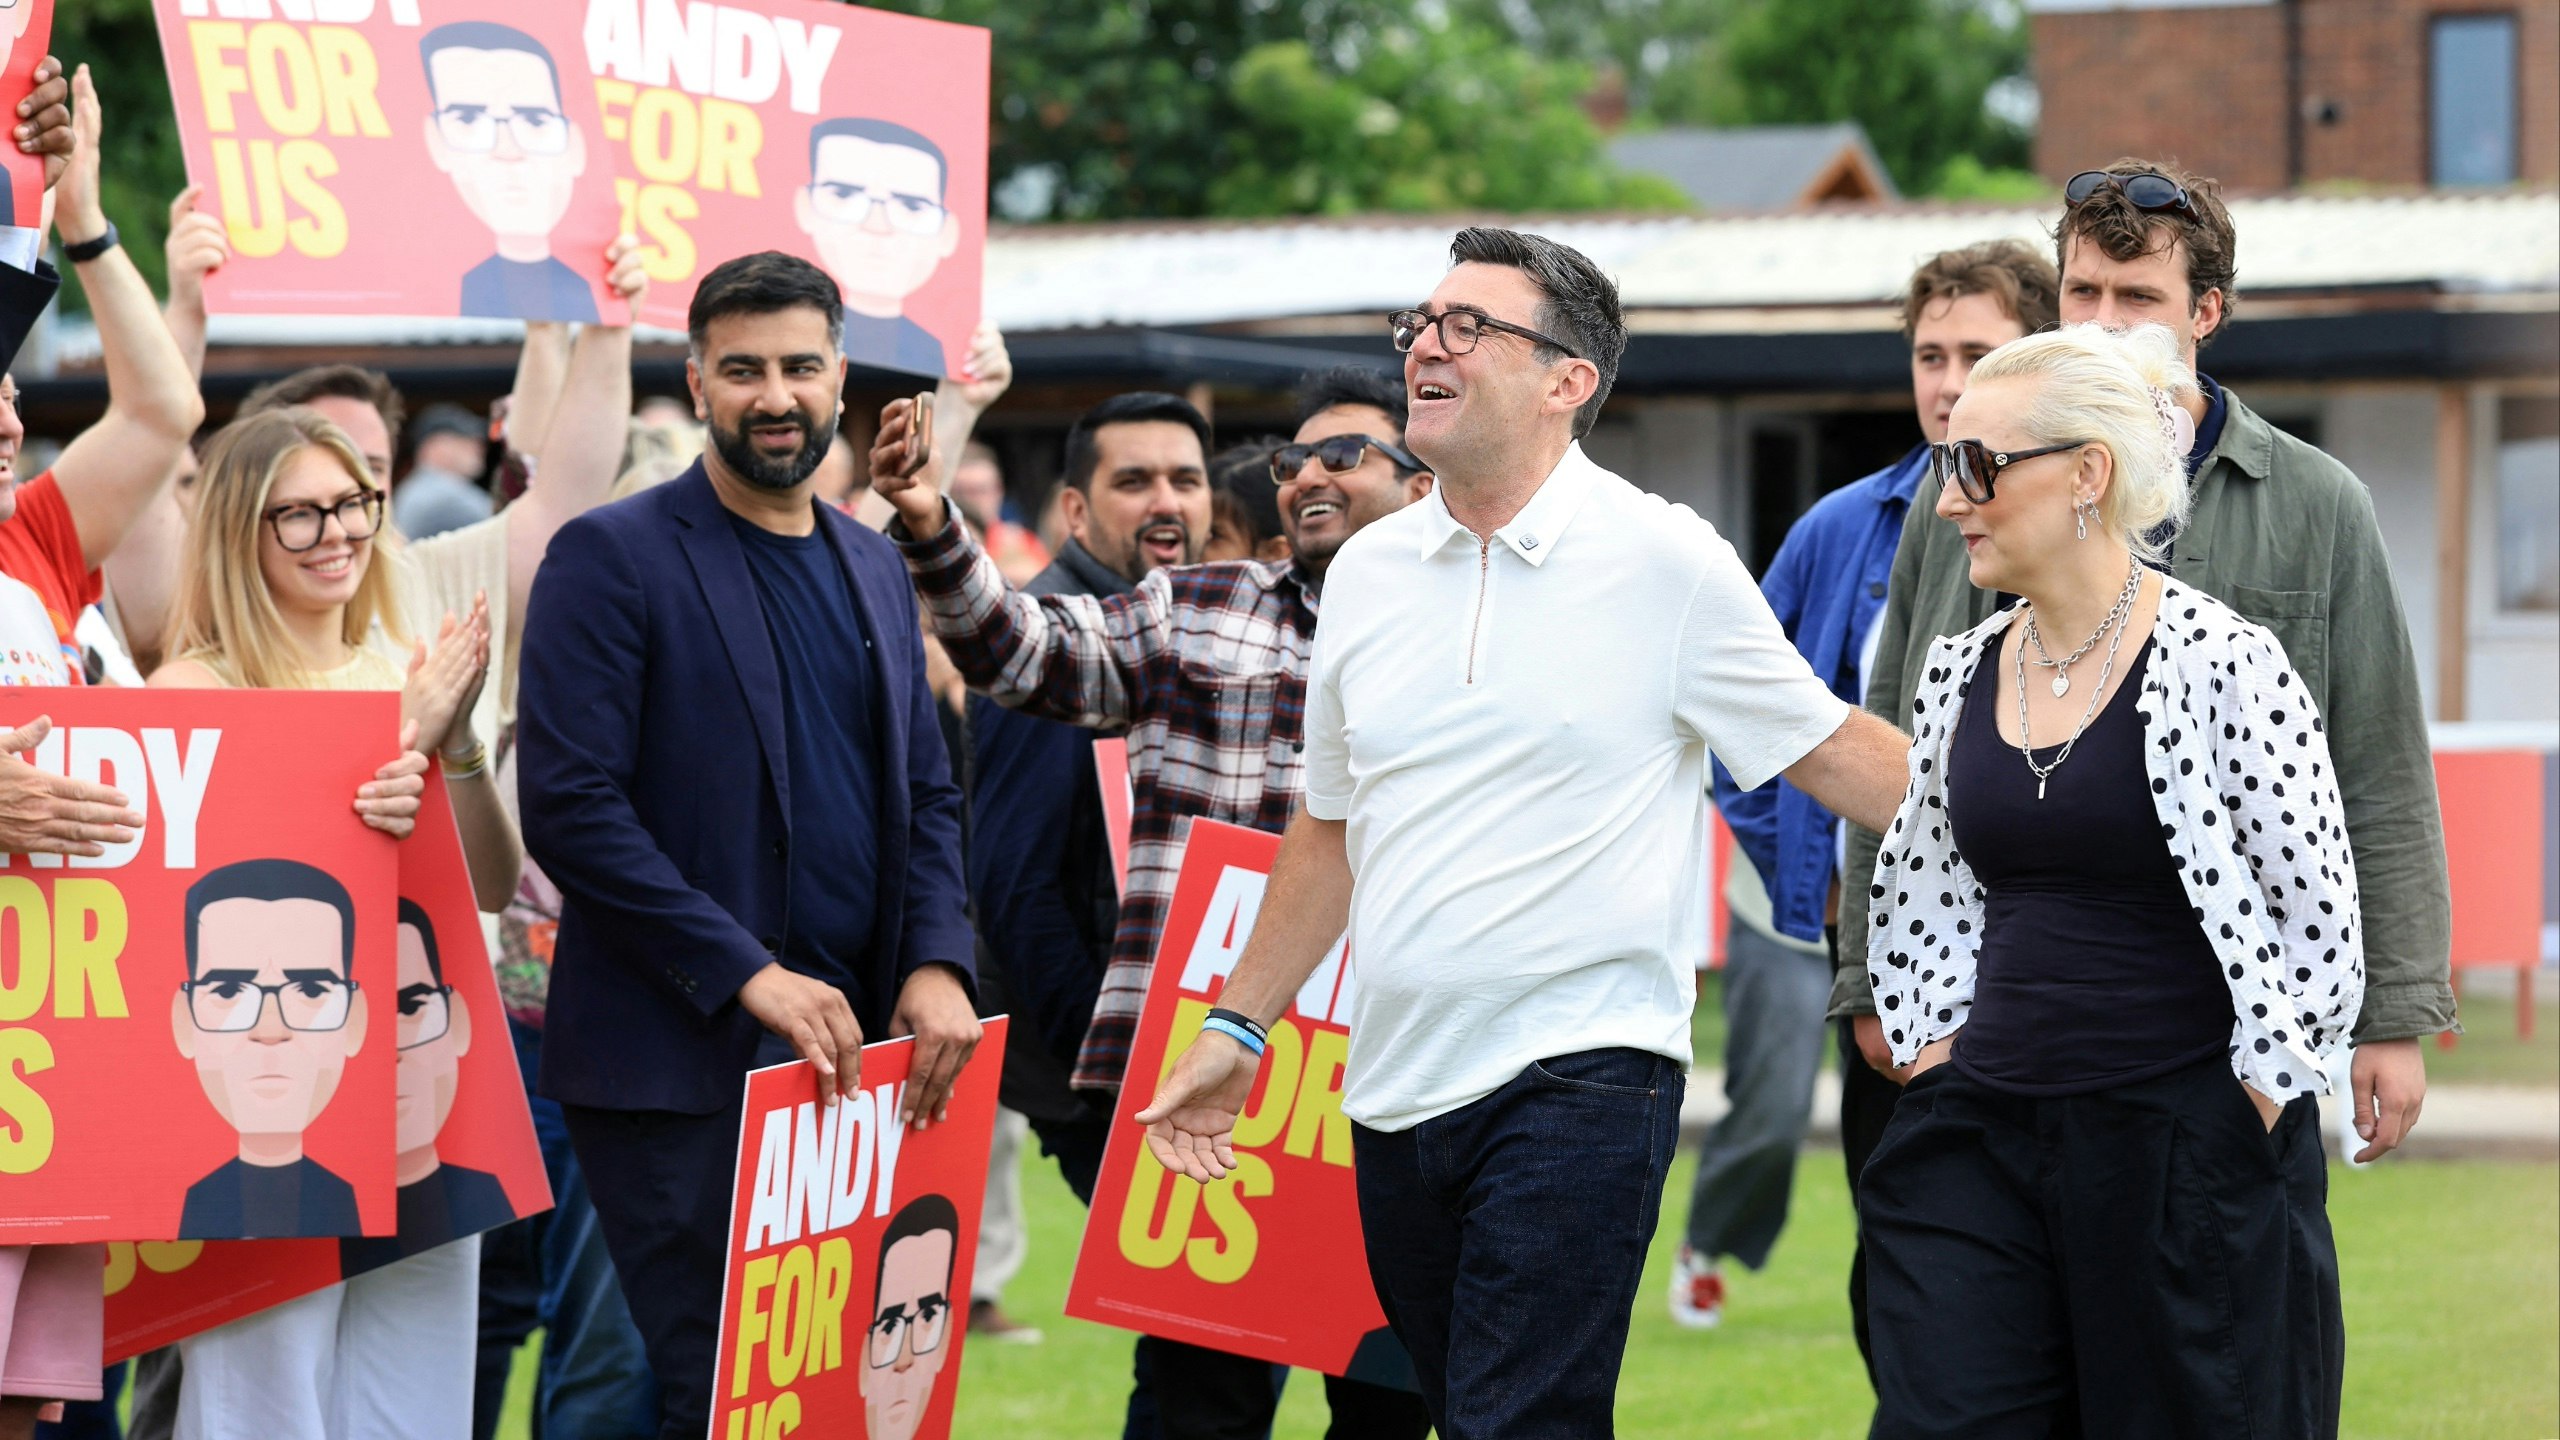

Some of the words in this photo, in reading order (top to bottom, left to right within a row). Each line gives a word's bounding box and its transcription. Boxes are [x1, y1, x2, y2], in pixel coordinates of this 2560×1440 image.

[187, 20, 392, 138] FOR
[583, 0, 842, 114] ANDY
[211, 138, 349, 258] US
[744, 1080, 907, 1252] ANDY
[1118, 1132, 1274, 1284] US
[732, 1236, 852, 1399] FOR
